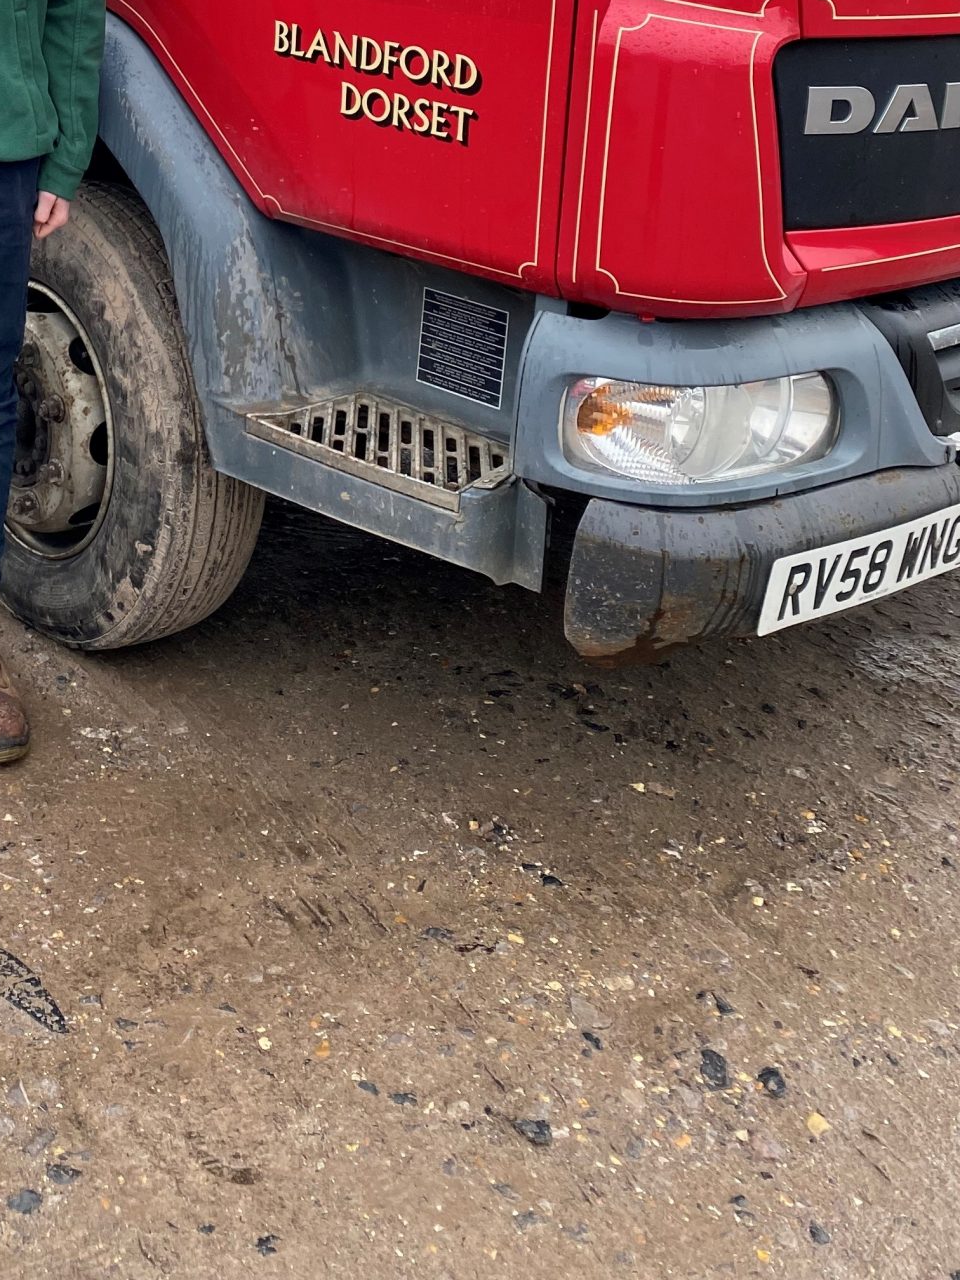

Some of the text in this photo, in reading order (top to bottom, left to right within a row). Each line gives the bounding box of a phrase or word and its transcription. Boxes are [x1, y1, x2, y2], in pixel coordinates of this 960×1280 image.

[274, 20, 479, 91] BLANDFORD
[340, 81, 475, 142] DORSET
[777, 539, 894, 622] RV58
